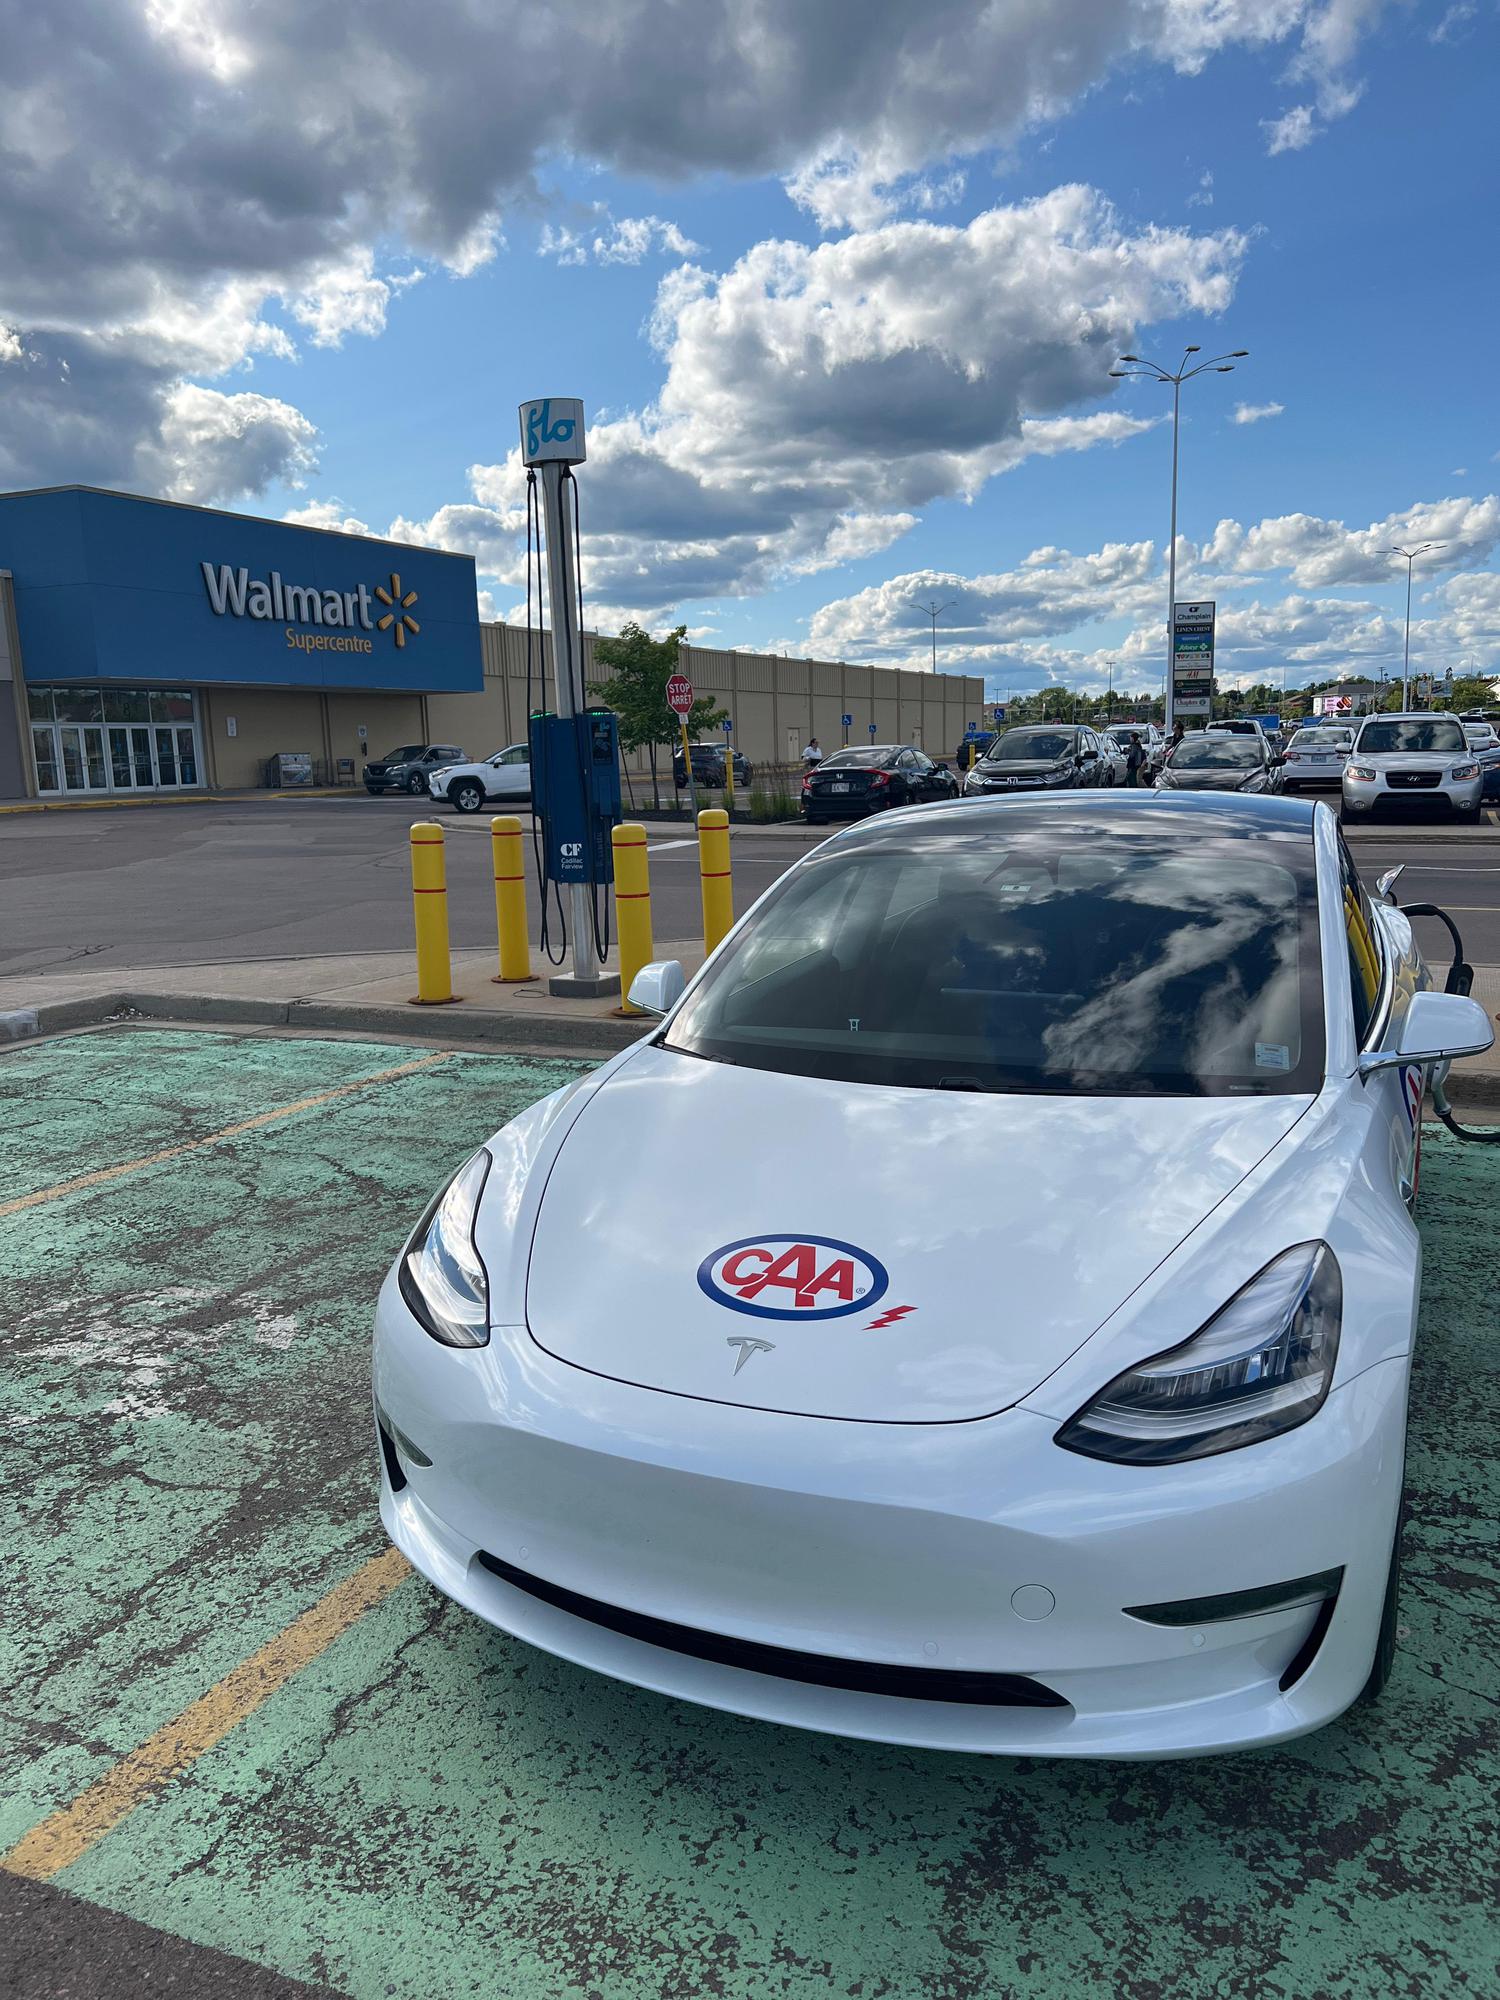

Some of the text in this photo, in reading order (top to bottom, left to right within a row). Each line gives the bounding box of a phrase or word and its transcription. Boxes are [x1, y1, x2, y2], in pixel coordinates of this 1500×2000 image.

[527, 399, 576, 456] flo
[202, 562, 373, 630] Walmart
[285, 628, 373, 654] Supercentre
[669, 683, 690, 694] STOP
[560, 843, 583, 857] CF
[721, 1243, 855, 1308] CAA
